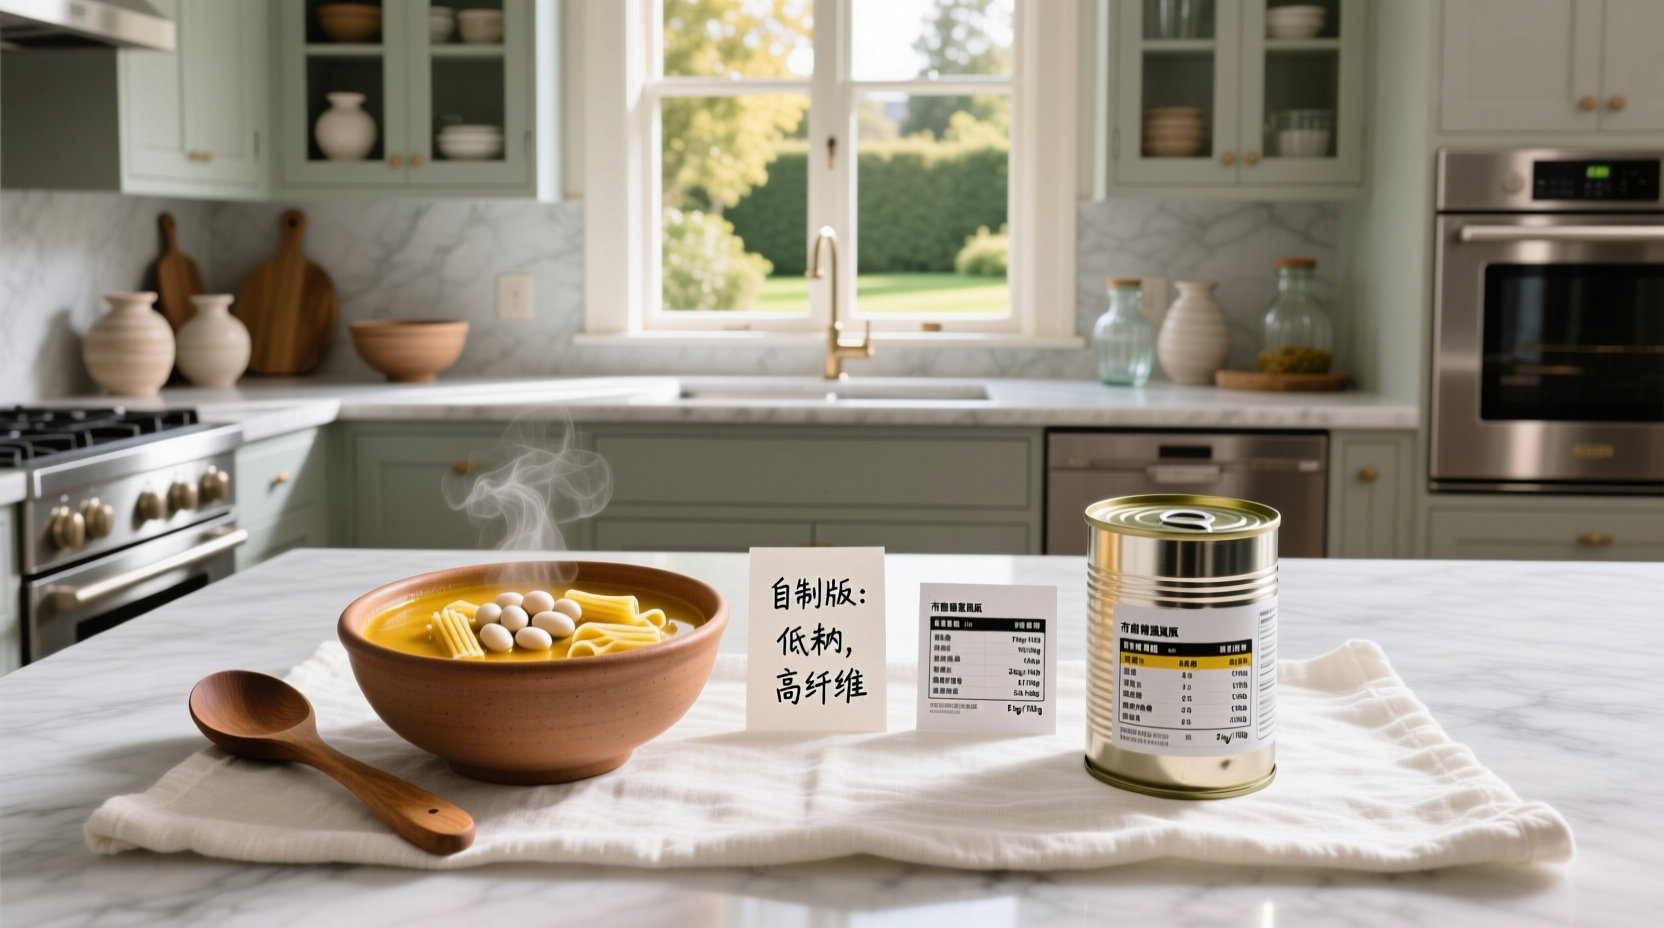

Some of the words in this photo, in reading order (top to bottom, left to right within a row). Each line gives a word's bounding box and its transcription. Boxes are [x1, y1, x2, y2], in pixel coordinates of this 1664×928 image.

[771, 576, 866, 611] 自制版：
[776, 667, 868, 706] 高纤维
